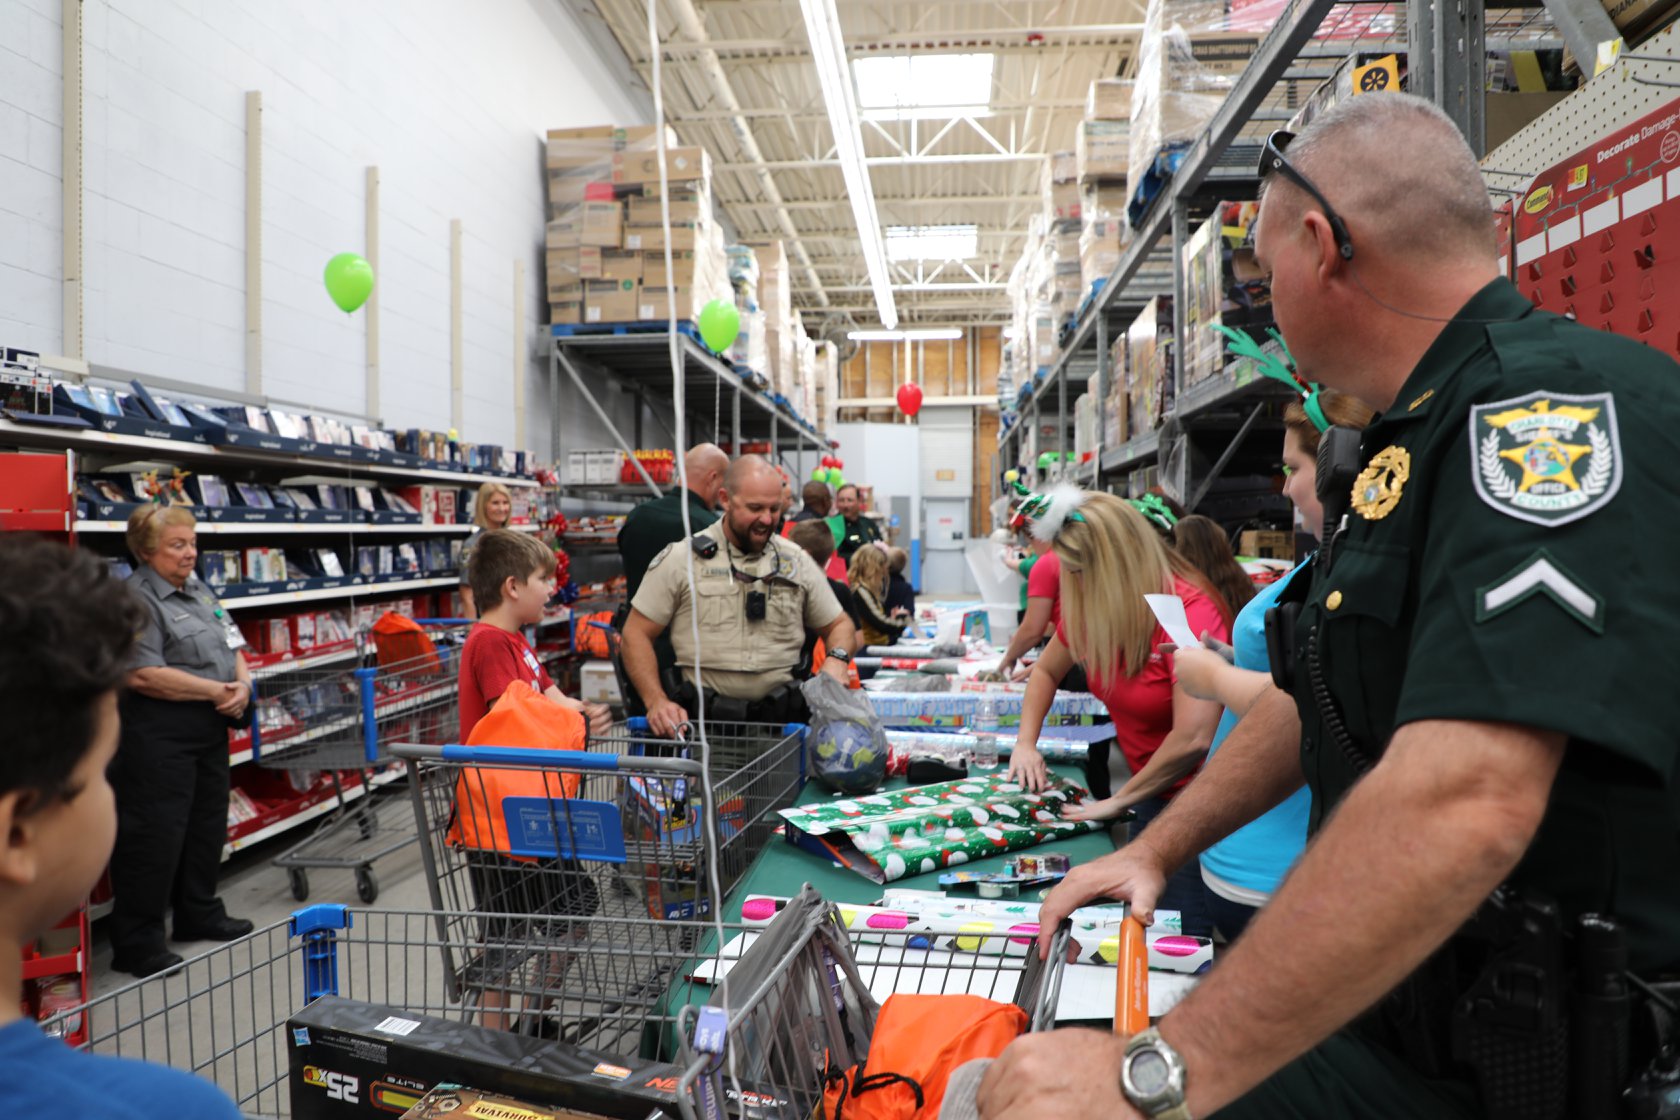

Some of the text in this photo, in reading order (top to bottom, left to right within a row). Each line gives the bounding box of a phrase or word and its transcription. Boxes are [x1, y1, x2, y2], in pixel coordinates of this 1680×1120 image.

[1597, 133, 1640, 164] Decorate
[1641, 108, 1680, 141] Damage-
[1510, 415, 1575, 432] CHARLOTTE
[1530, 483, 1567, 494] OFFICE
[1516, 492, 1584, 508] COUNTY
[386, 1076, 425, 1090] ELITE
[474, 1105, 538, 1120] SURVIVAL
